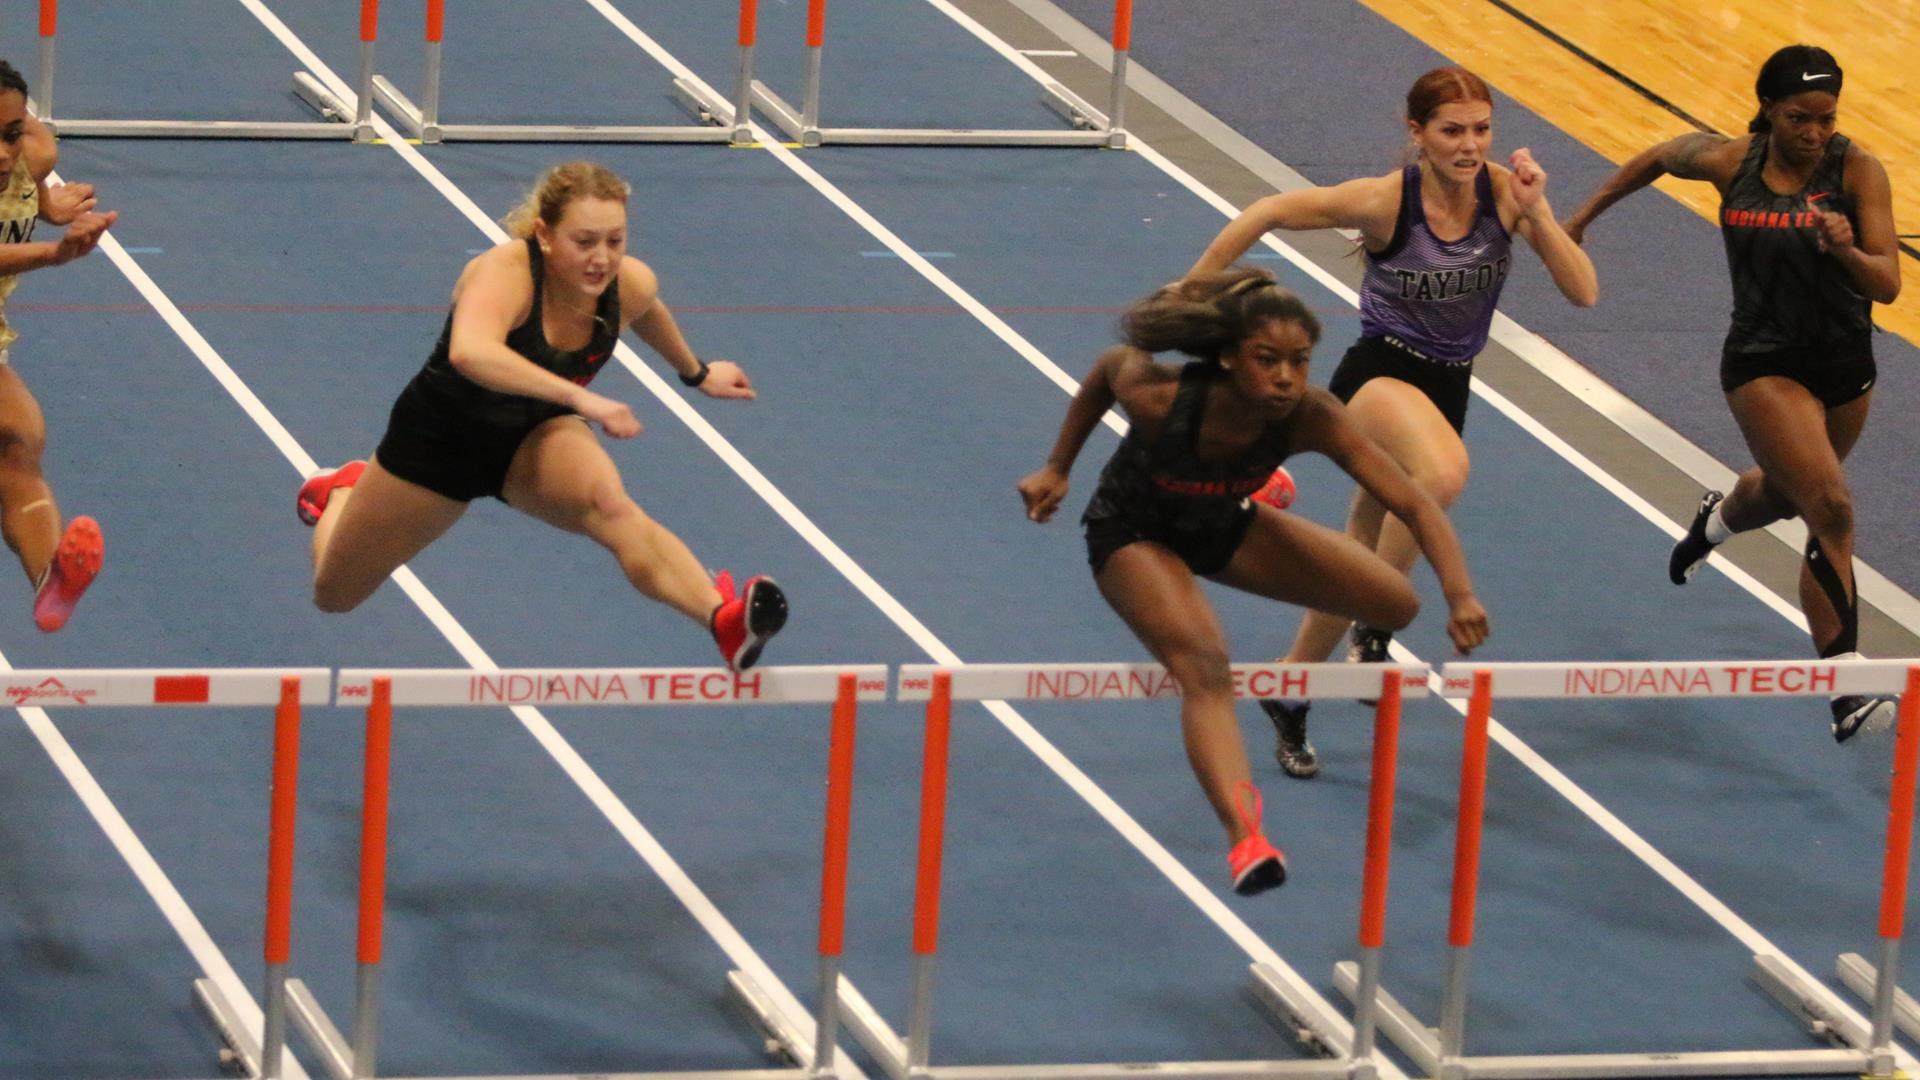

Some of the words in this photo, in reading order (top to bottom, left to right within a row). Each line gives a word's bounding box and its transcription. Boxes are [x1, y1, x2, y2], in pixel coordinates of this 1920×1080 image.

[1725, 209, 1790, 228] INDIANA
[1795, 212, 1814, 228] TE
[468, 674, 629, 702] INDIANA
[640, 672, 762, 700] TECH
[1026, 670, 1180, 698] INDIANA
[1230, 669, 1309, 697] ECH
[1563, 667, 1712, 695] INDIANA
[1723, 665, 1837, 693] TECH
